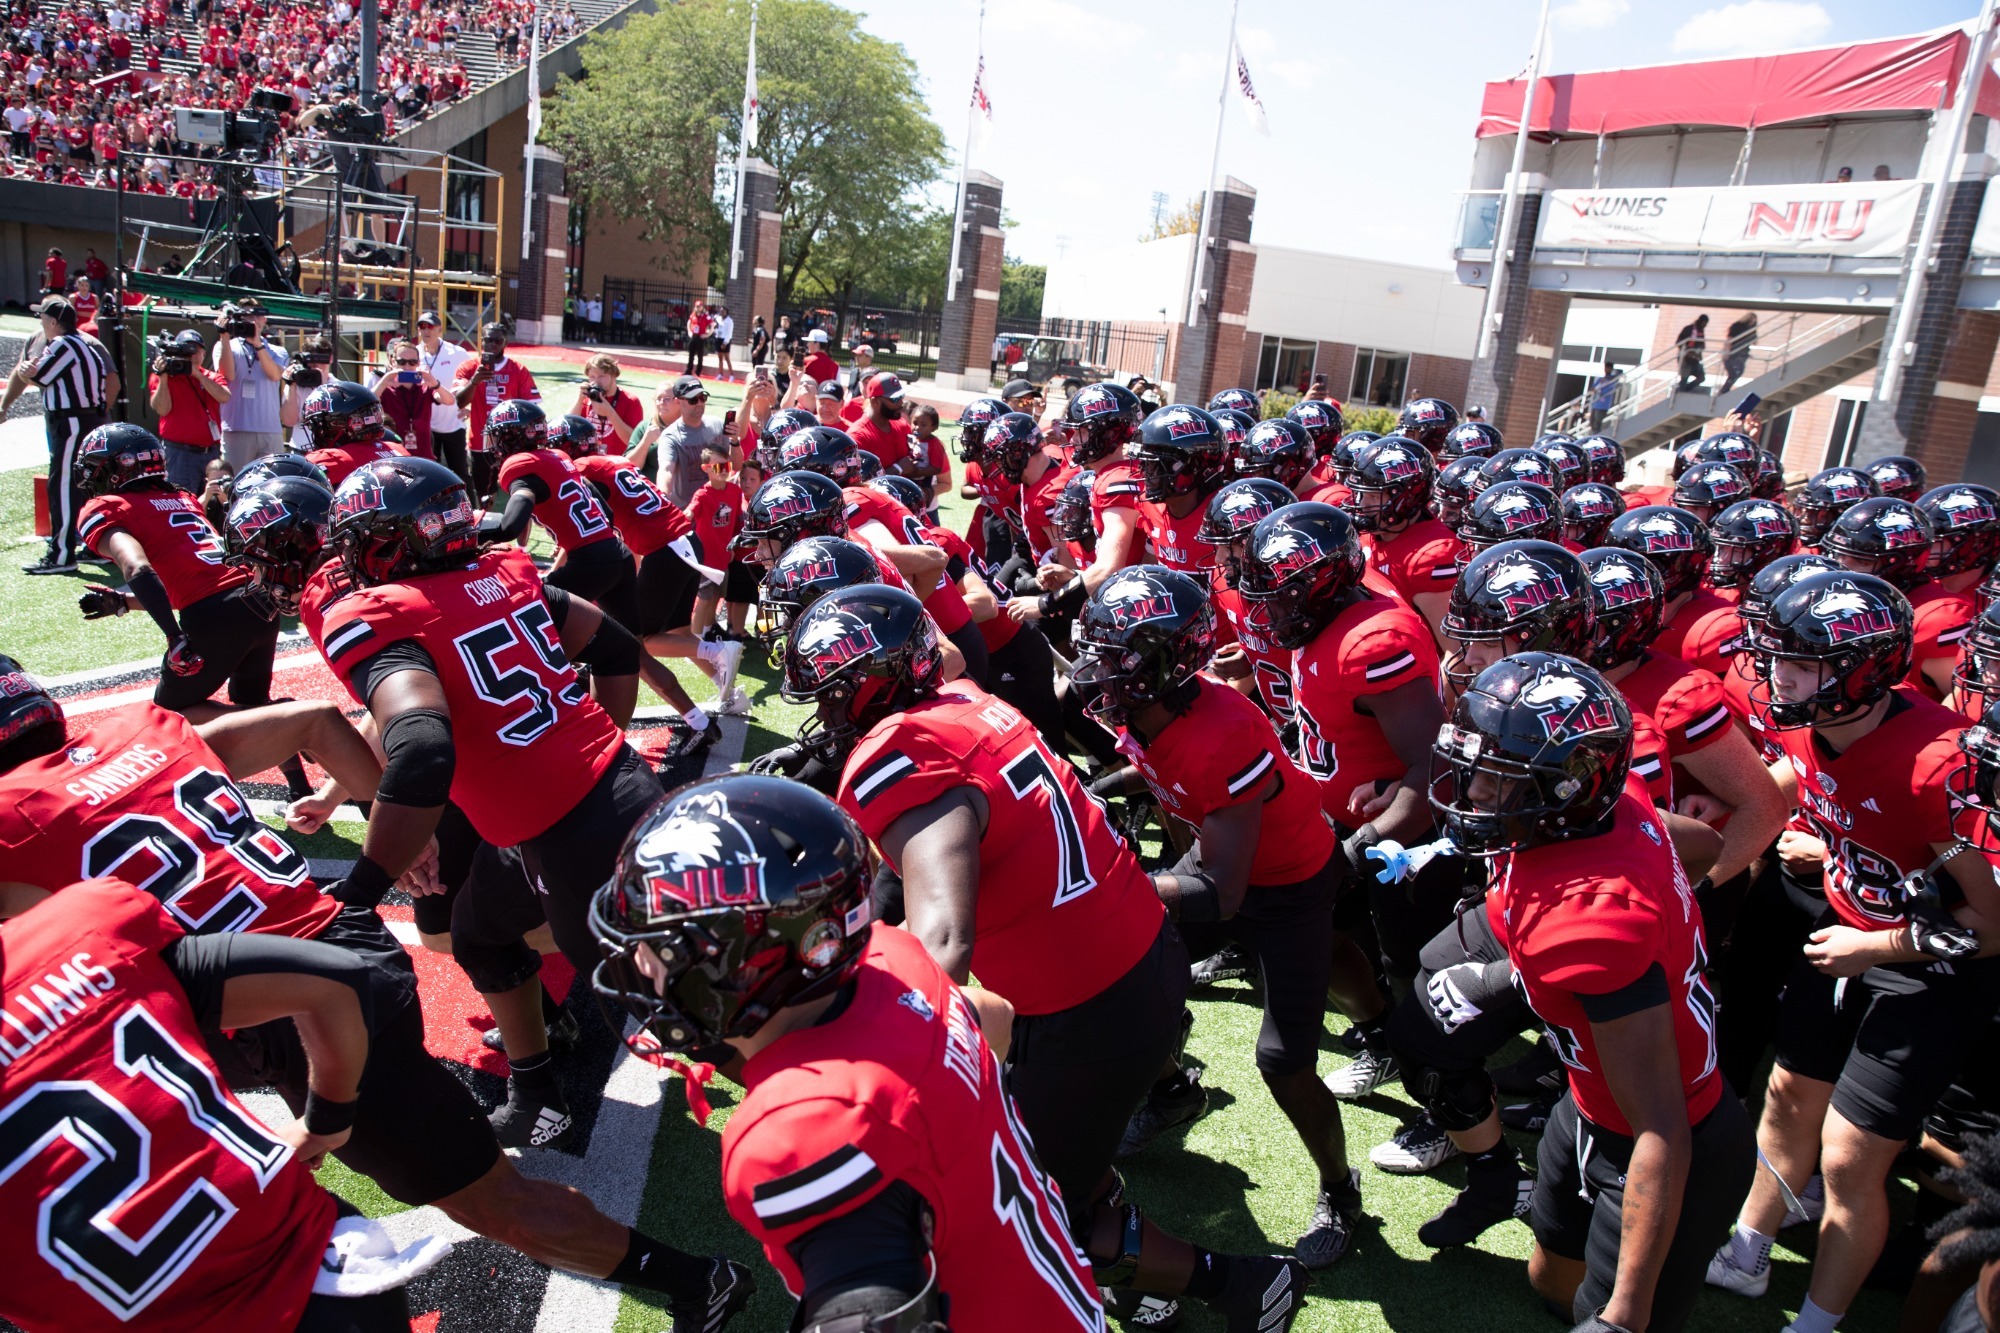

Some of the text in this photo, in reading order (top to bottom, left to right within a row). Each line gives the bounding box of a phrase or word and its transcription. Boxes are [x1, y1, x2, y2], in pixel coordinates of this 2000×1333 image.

[1585, 196, 1668, 217] KUNES
[1743, 200, 1875, 241] NIU
[305, 399, 332, 415] NIU
[1083, 400, 1118, 417] NIU
[1229, 400, 1251, 410] NIU
[1418, 409, 1444, 422] NIU
[493, 410, 520, 426] NIU
[1169, 420, 1208, 439] NIU
[1302, 415, 1329, 427] NIU
[784, 440, 817, 463] NIU
[1260, 431, 1293, 455] NIU
[1463, 437, 1491, 452] NIU
[1590, 446, 1616, 460] NIU
[1725, 450, 1752, 463] NIU
[1384, 459, 1420, 482] NIU
[1713, 480, 1743, 499] NIU
[1834, 486, 1869, 502] NIU
[1880, 476, 1911, 491] NIU
[335, 487, 385, 526] NIU
[769, 494, 815, 524] NIU
[1231, 502, 1273, 530] NIU
[1582, 501, 1613, 516] NIU
[1951, 506, 1993, 526] NIU
[237, 500, 289, 541] NIU
[1504, 507, 1548, 533] NIU
[1757, 519, 1791, 536] NIU
[1647, 533, 1692, 552] NIU
[1886, 528, 1925, 548] NIU
[1158, 544, 1187, 562] NIU
[1271, 539, 1324, 581] NIU
[786, 557, 838, 588] NIU
[464, 574, 510, 606] CURRY
[1503, 577, 1567, 619] NIU
[1604, 581, 1652, 608] NIU
[1115, 592, 1177, 623] NIU
[1829, 609, 1893, 643] NIU
[814, 625, 880, 680] NIU
[453, 599, 585, 746] 55
[1546, 698, 1616, 735] NIU
[65, 743, 168, 806] SANDERS
[1804, 786, 1854, 830] NIU
[81, 764, 310, 933] 28
[650, 862, 765, 919] NIU
[530, 1114, 572, 1146] adidas
[0, 1003, 296, 1323] 21
